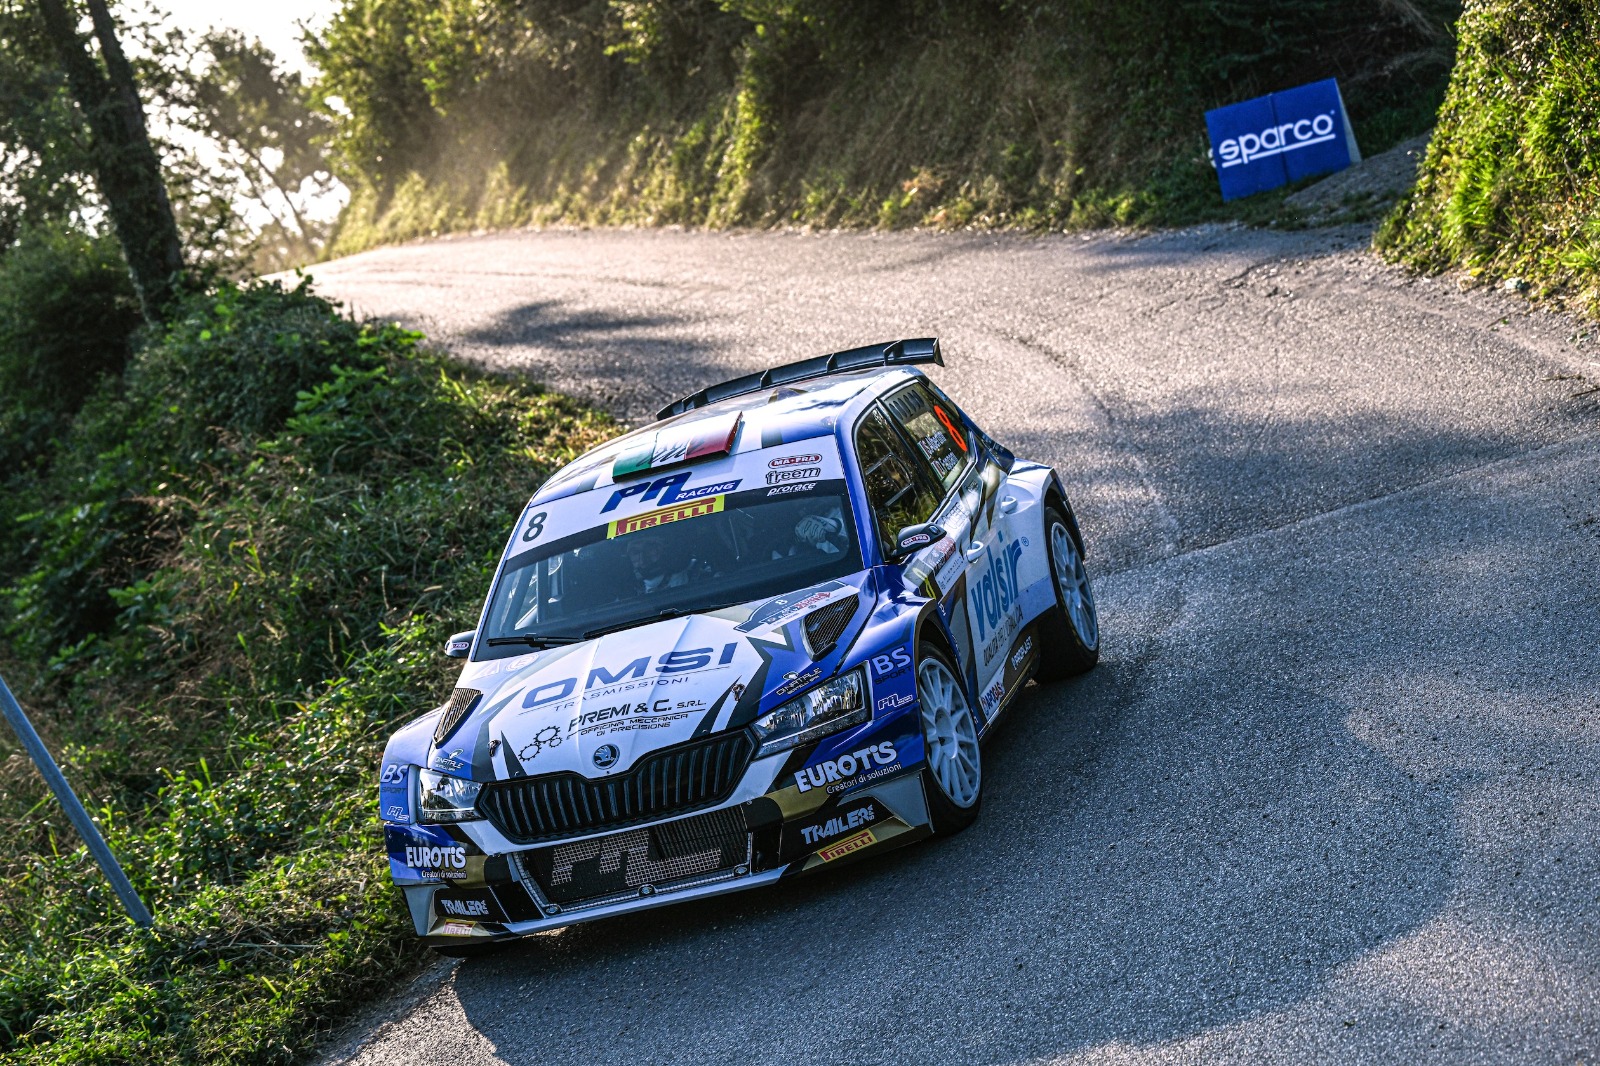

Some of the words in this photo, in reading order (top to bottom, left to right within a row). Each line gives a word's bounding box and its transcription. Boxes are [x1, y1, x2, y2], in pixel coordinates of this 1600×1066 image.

[1219, 114, 1334, 165] sparco
[932, 404, 968, 452] 8
[766, 467, 821, 485] freem
[766, 482, 817, 497] prorace
[599, 471, 693, 515] PA
[675, 482, 737, 501] RACING
[522, 512, 548, 543] 8
[616, 497, 717, 536] PIRELLI
[970, 531, 1023, 642] valsir
[872, 646, 911, 675] BS
[875, 666, 912, 685] SPORT
[520, 642, 739, 710] OMSI
[553, 677, 690, 712] TRASMISSIONI
[568, 703, 630, 732] PREMI
[634, 702, 649, 714] &
[653, 699, 673, 713] C.
[580, 719, 625, 736] OFFICINA
[629, 713, 690, 724] MECCANICA
[610, 722, 671, 734] PRECISIONE
[381, 764, 409, 785] BS
[826, 777, 858, 795] Creatori
[858, 774, 867, 785] di
[867, 762, 902, 781] soluzioni
[381, 786, 407, 794] SPORT
[801, 807, 869, 844] TRAILER
[820, 831, 874, 861] PIRELLI
[421, 869, 441, 879] Creatori
[445, 870, 467, 880] soluzioni
[440, 899, 483, 916] TRAILER
